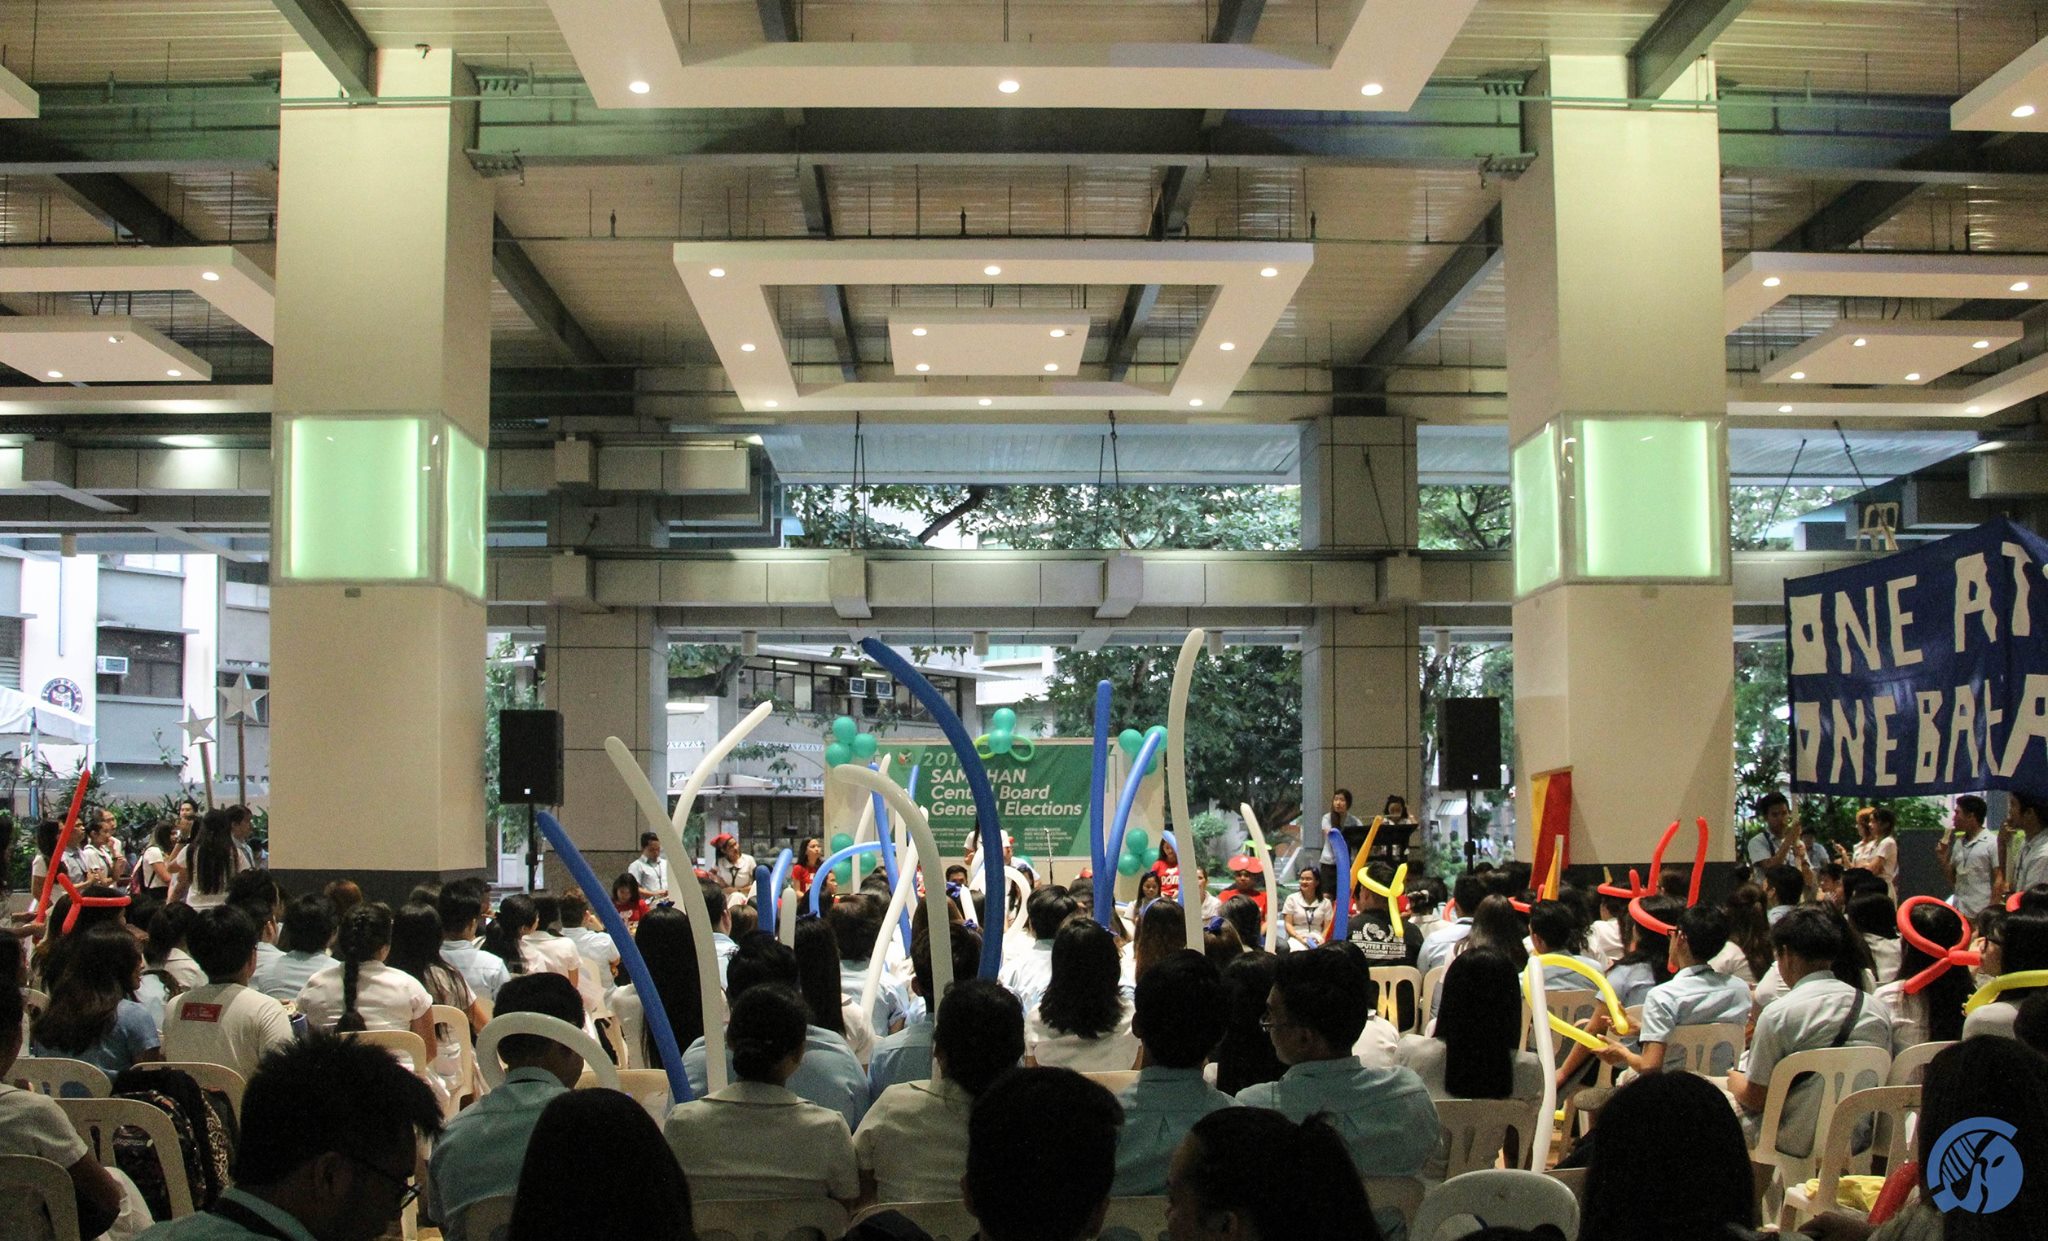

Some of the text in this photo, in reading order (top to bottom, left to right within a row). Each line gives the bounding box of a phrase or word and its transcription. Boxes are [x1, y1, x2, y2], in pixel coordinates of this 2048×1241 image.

[1789, 575, 1924, 675] ONE
[1794, 696, 1898, 786] ONE
[922, 752, 960, 767] 201
[930, 768, 1027, 784] SAMHAN
[999, 784, 1050, 800] Board
[931, 800, 1083, 816] Genel Elections
